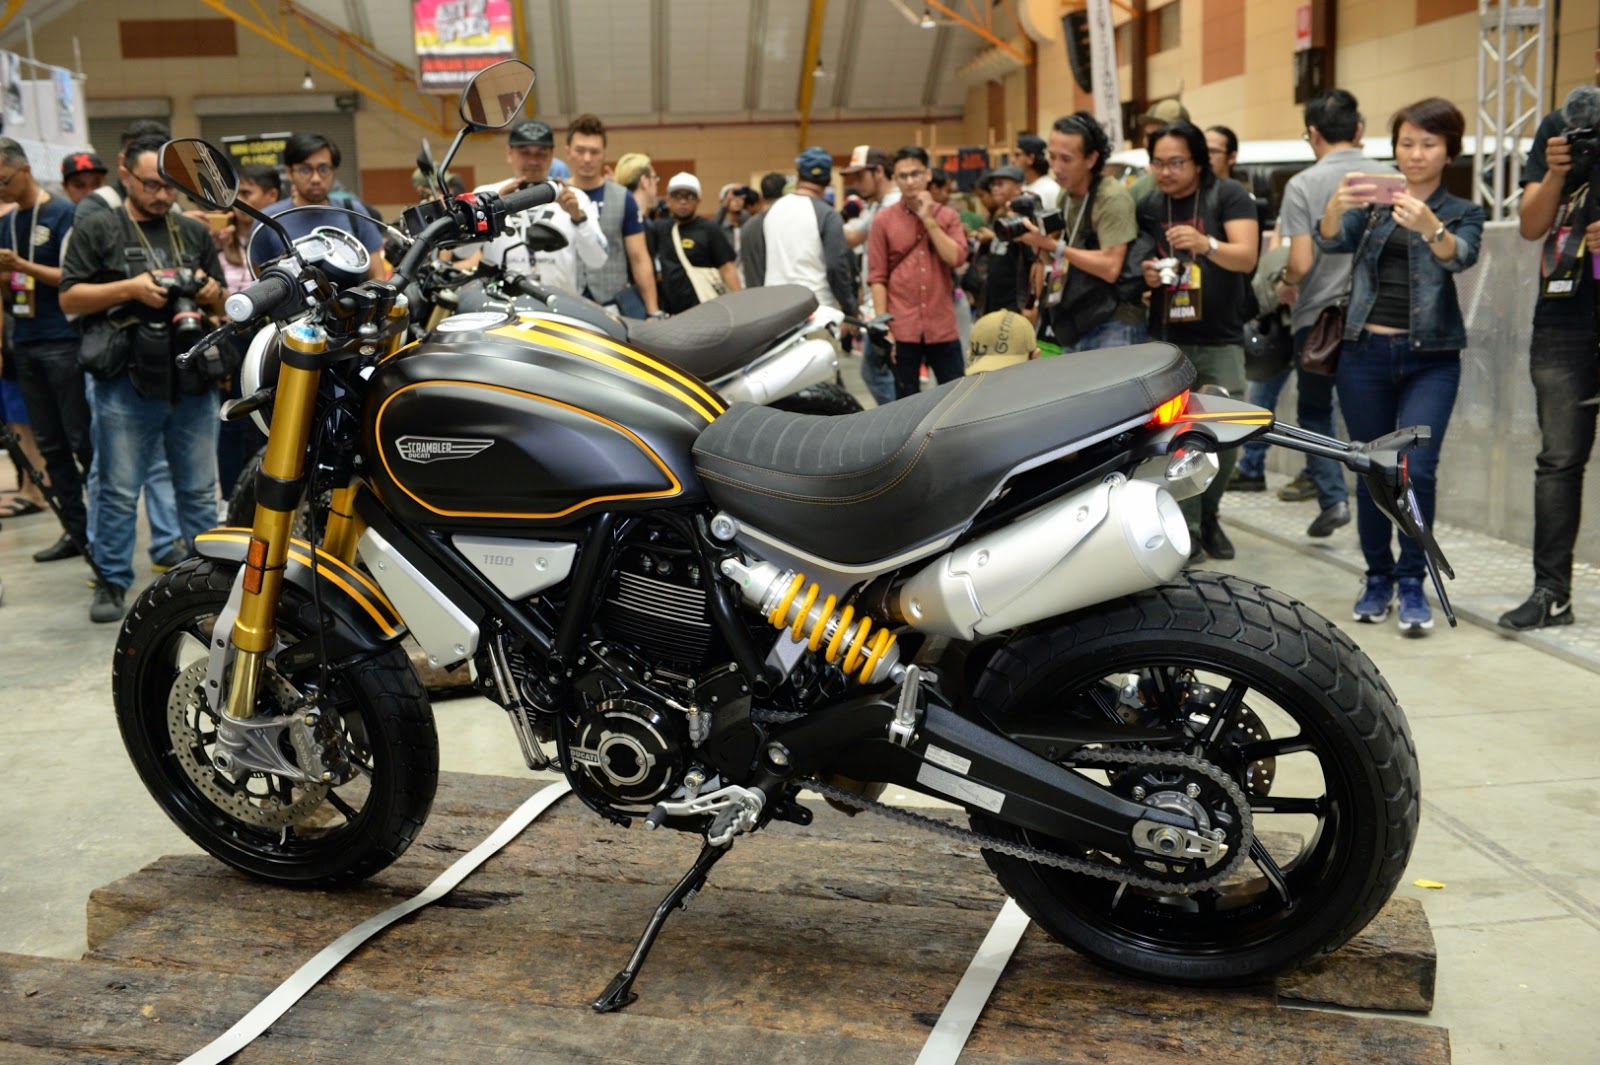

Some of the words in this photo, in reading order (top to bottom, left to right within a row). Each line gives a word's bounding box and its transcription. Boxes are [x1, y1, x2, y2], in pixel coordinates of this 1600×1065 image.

[1169, 305, 1196, 318] MEDIA
[407, 442, 452, 453] SCRAMBLER
[482, 554, 514, 566] 1100
[570, 748, 598, 762] DUCATI
